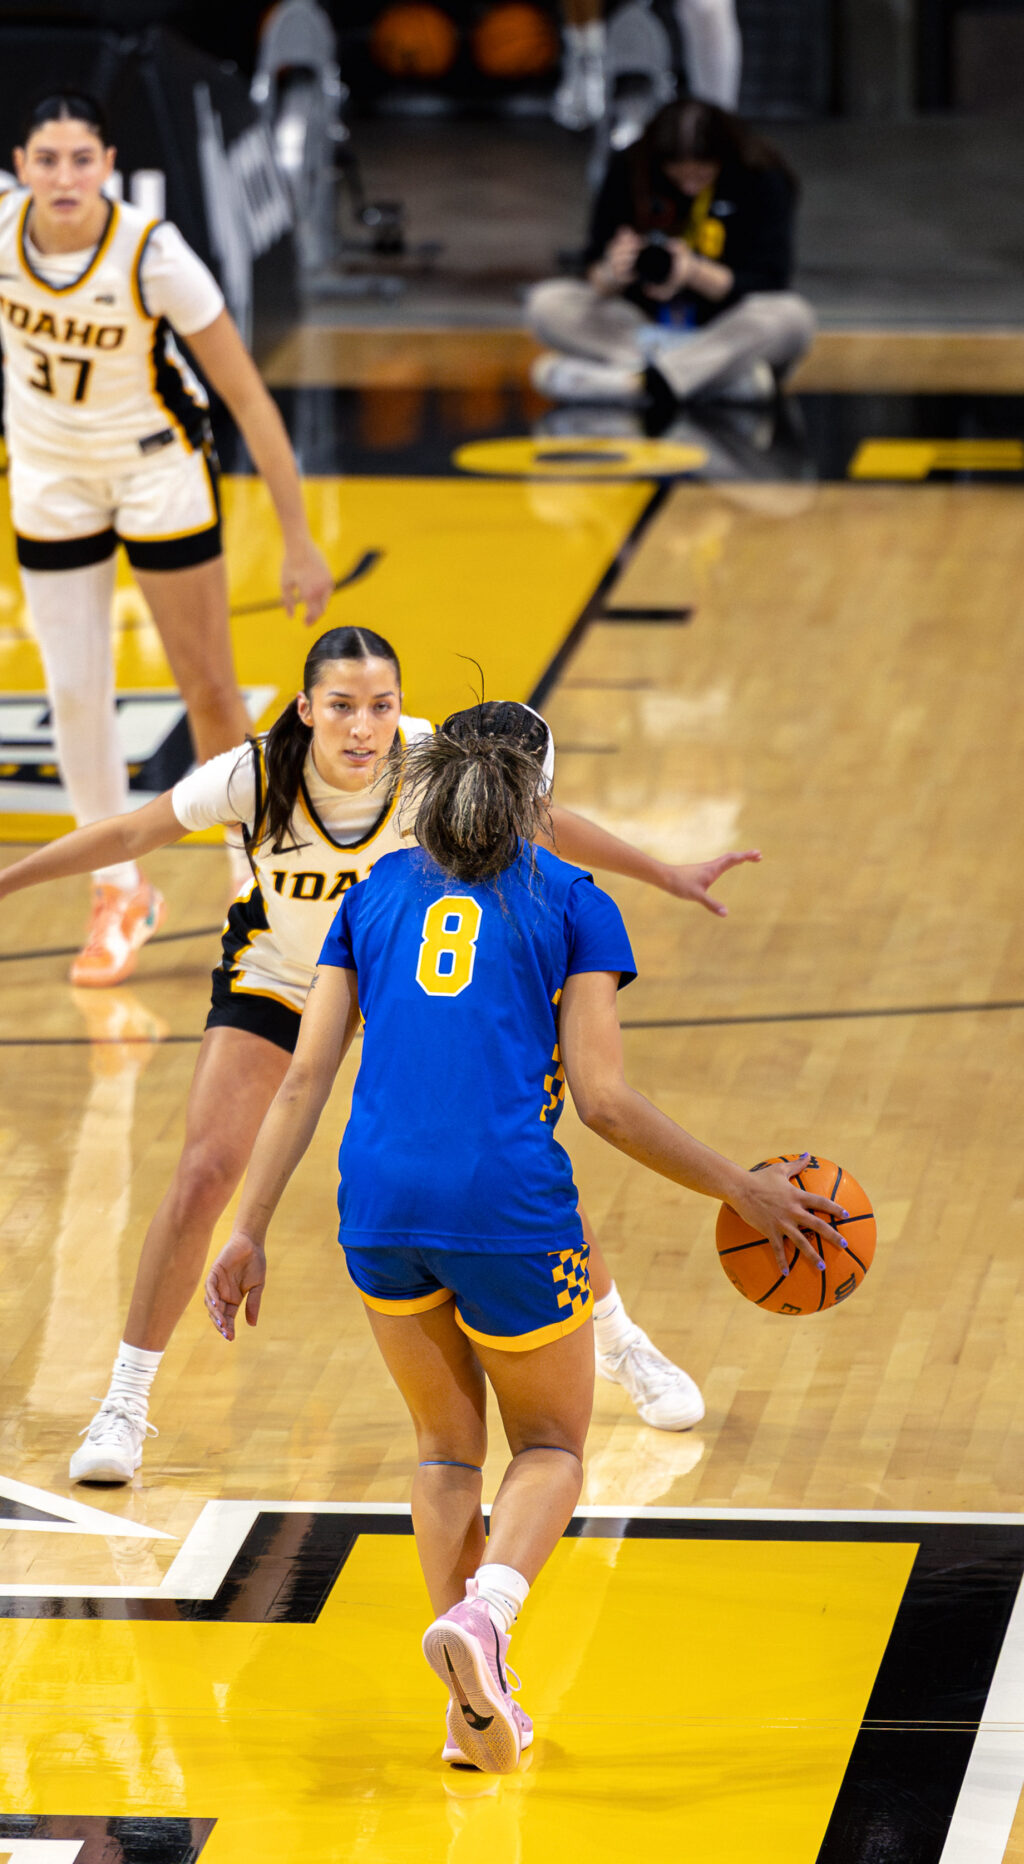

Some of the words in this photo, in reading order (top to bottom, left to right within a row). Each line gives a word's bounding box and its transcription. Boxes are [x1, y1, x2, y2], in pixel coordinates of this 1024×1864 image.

[24, 341, 92, 407] 37
[271, 863, 374, 902] IDA
[415, 895, 483, 997] 8
